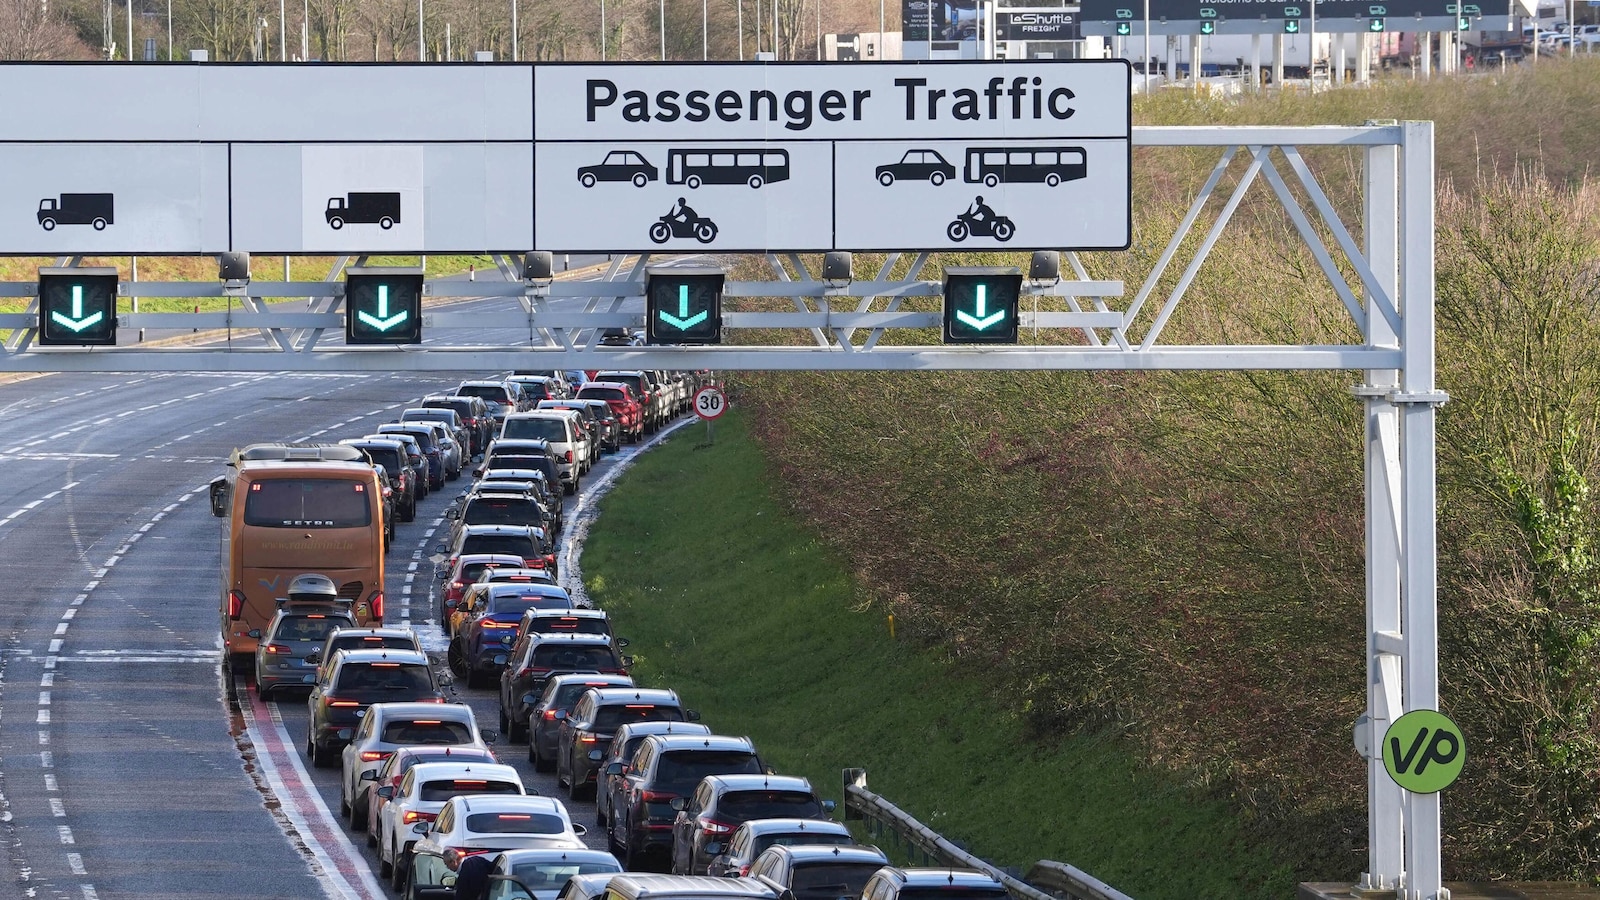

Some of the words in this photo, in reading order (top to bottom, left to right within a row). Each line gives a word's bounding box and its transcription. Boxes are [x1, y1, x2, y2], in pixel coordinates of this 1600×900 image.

[1010, 13, 1073, 24] LeShuttle
[586, 79, 870, 131] Passenger
[894, 76, 1077, 121] Traffic
[700, 395, 719, 410] 30
[1390, 727, 1459, 775] VP
